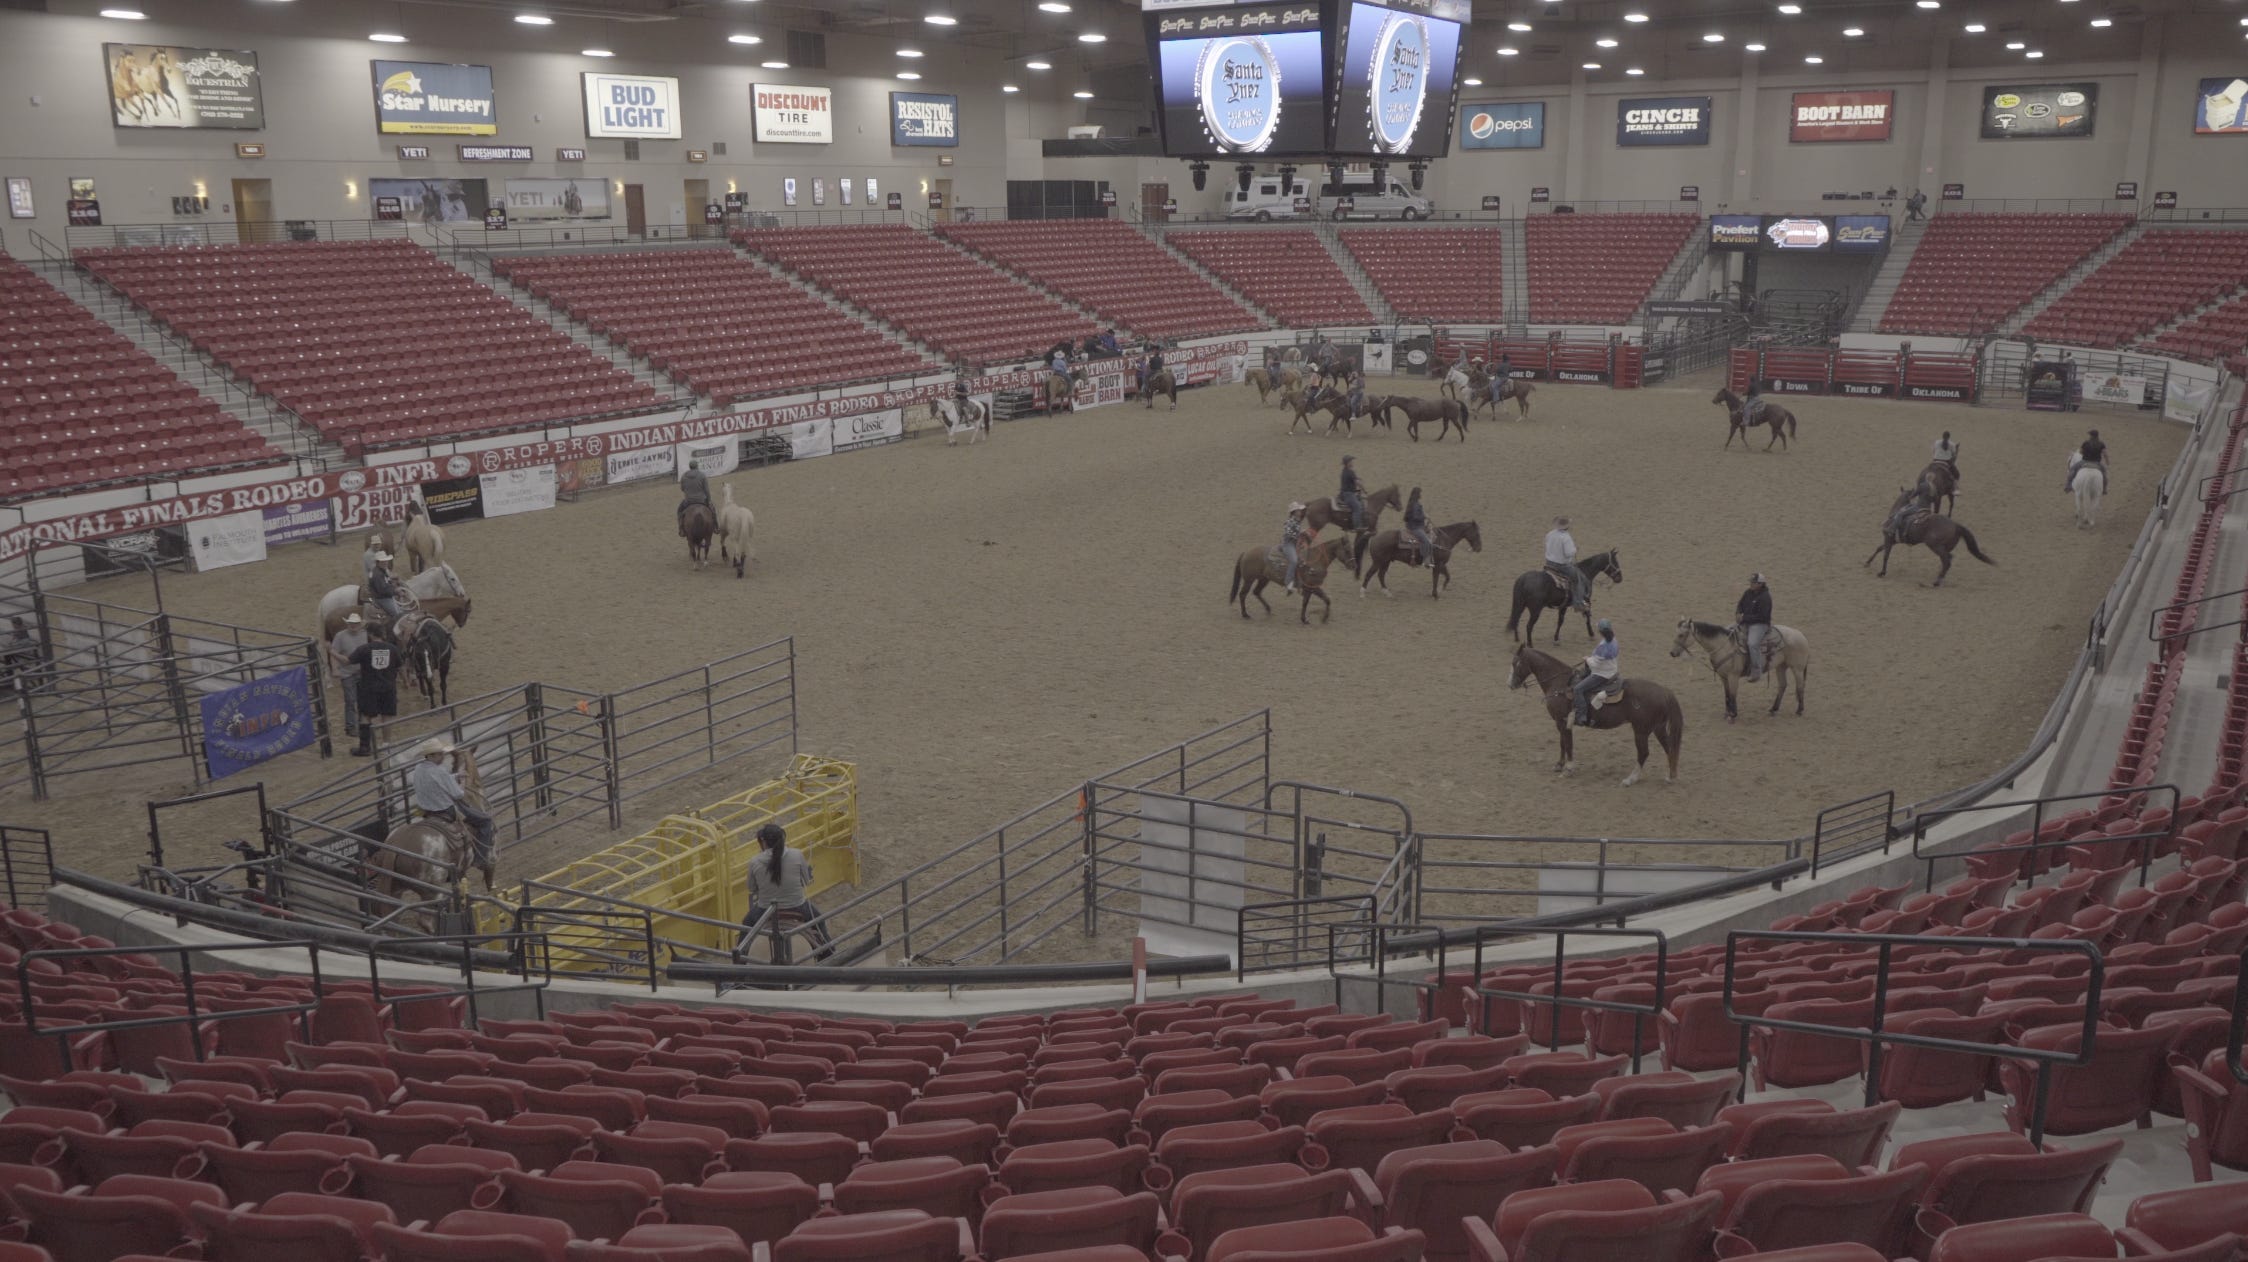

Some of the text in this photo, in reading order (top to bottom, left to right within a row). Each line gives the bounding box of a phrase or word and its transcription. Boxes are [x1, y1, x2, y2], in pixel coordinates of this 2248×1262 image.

[1390, 38, 1420, 69] Santa
[1223, 59, 1263, 82] Santa
[186, 75, 249, 87] EQUESTRIAN
[611, 84, 656, 105] BUD
[1226, 82, 1260, 103] Ynez
[382, 92, 490, 116] Star Nursery
[758, 92, 827, 112] DISCOUNT
[604, 107, 665, 128] LIGHT
[778, 112, 808, 124] TIRE
[897, 101, 953, 120] RESISTOL
[1625, 108, 1699, 124] CINCH
[1797, 104, 1886, 121] BOOT BARN
[766, 128, 822, 137] discounttire.com
[923, 119, 954, 138] HATS
[1494, 116, 1533, 134] pepsi
[1625, 124, 1654, 133] JEANS
[1663, 122, 1698, 130] SHIRTS
[402, 147, 427, 157] YETI
[463, 147, 531, 159] REFRESHMENT ZONE
[562, 150, 583, 159] YETI
[508, 191, 544, 206] YETI
[1712, 223, 1759, 235] Priefert
[1712, 234, 1758, 243] Pavilion
[1164, 350, 1194, 366] RODEO
[973, 374, 1019, 389] ROPER
[1099, 374, 1121, 389] BOOT
[1559, 371, 1599, 382] OKLAHOMA
[896, 383, 946, 402] ROPER
[1098, 388, 1121, 402] BARN
[1845, 384, 1869, 394] TRIBE
[1912, 387, 1961, 398] OKLAHOMA
[609, 395, 879, 451] INDIAN NATIONAL FINALS RODEO
[852, 416, 884, 434] Classic
[504, 437, 584, 462] ROPER
[375, 461, 439, 488] INFR
[369, 486, 414, 507] BOOT
[0, 512, 115, 560] ATIONAL
[121, 493, 224, 529] FINALS
[231, 477, 325, 511] RODEO
[369, 502, 411, 525] BAR
[376, 656, 384, 667] 12
